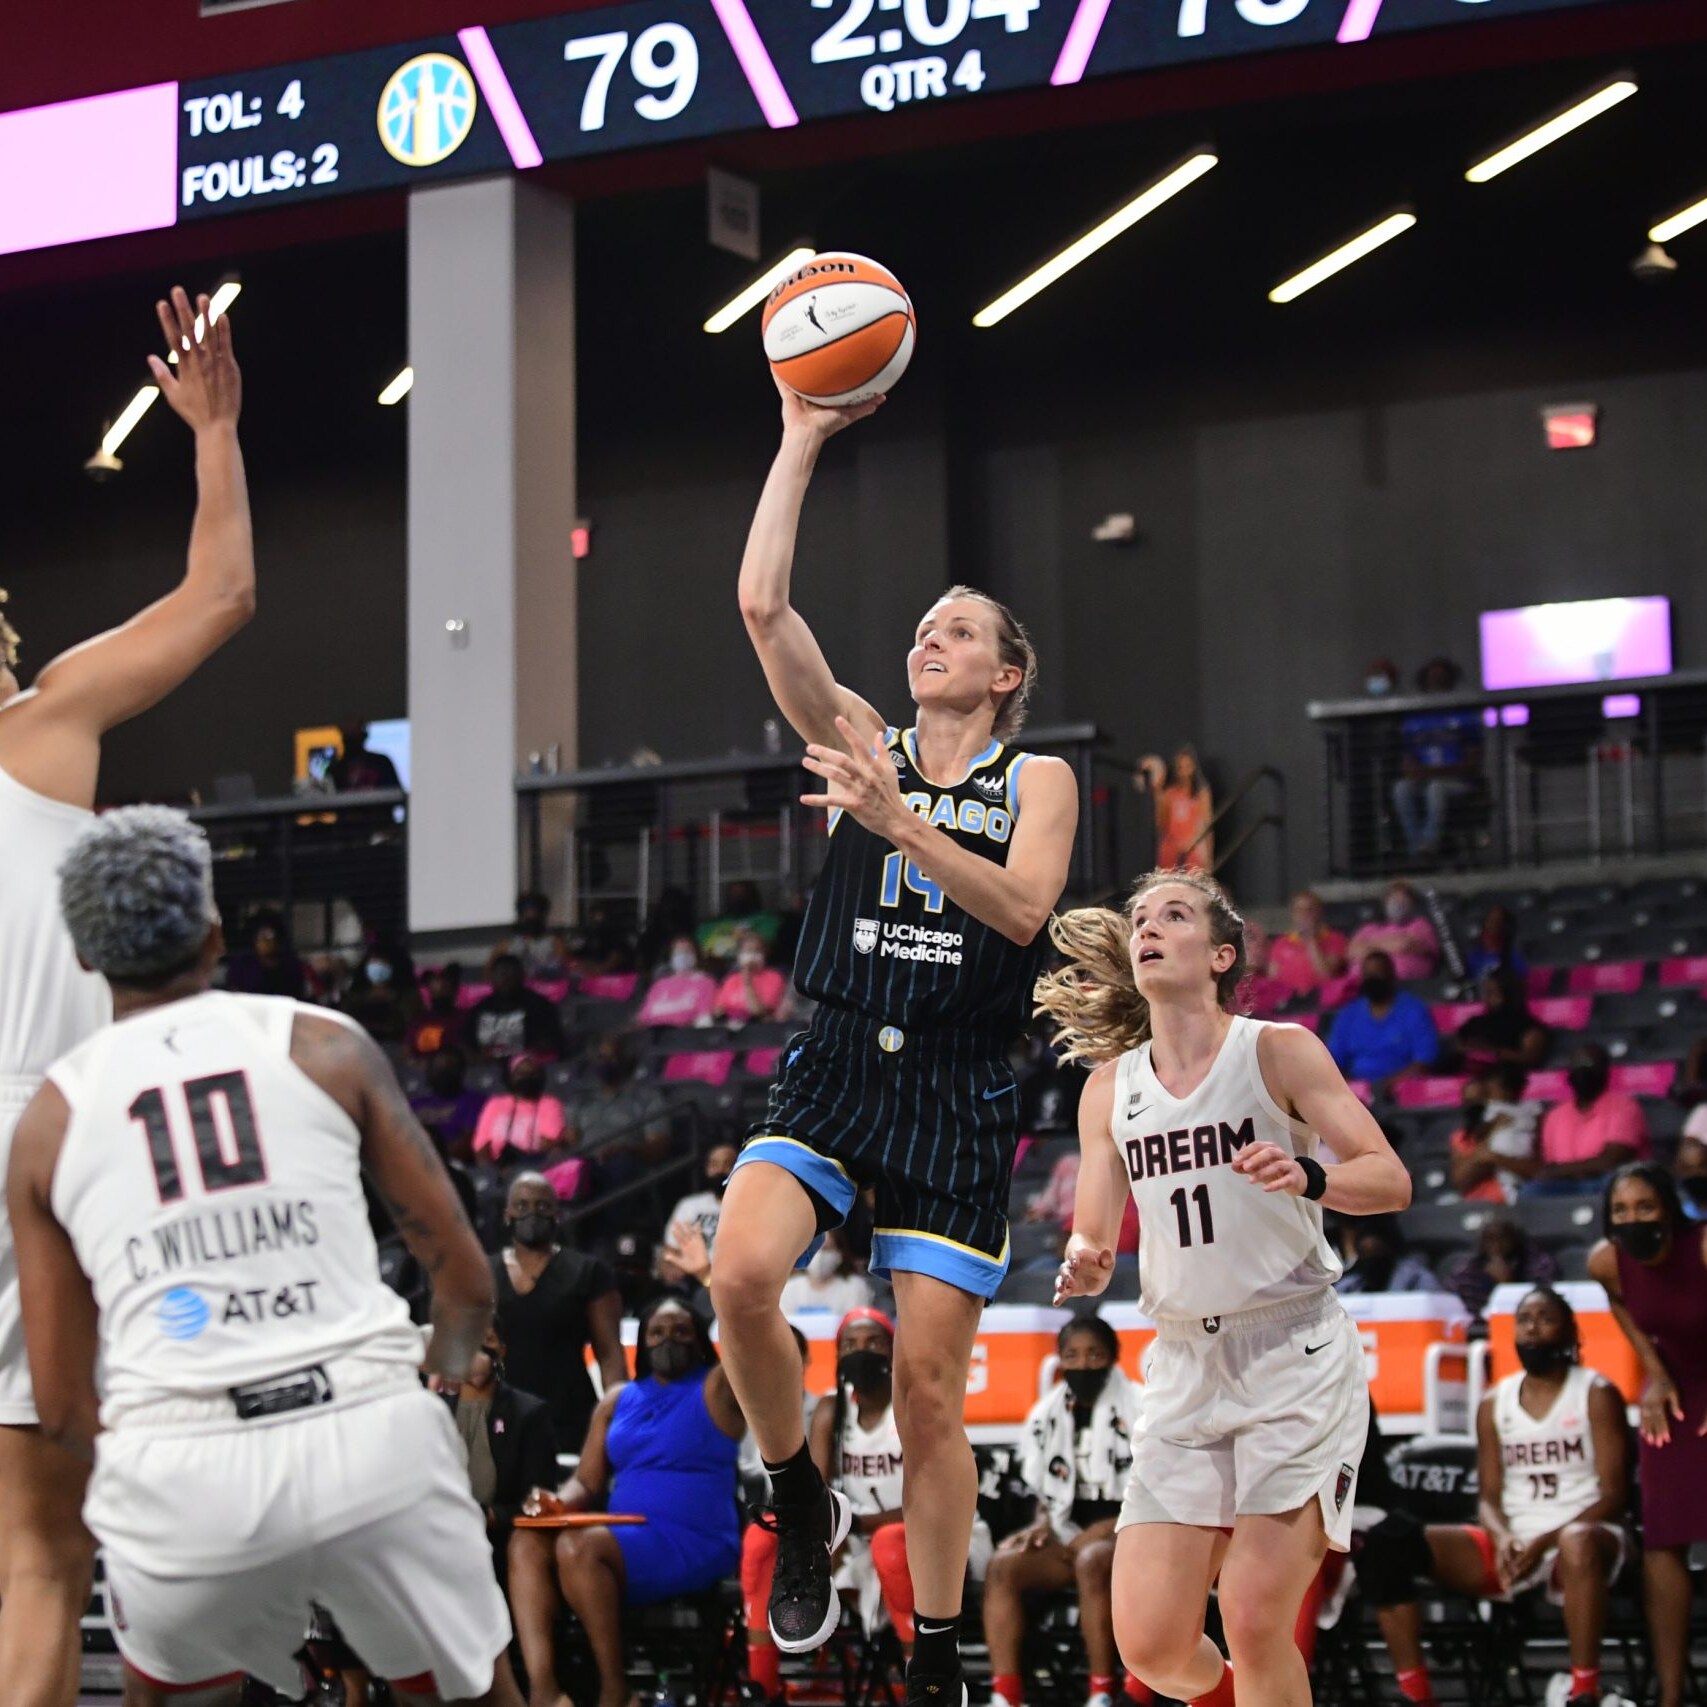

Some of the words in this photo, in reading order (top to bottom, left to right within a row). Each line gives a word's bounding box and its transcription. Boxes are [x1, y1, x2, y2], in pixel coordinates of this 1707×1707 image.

[564, 22, 699, 131] 79
[860, 56, 948, 111] QTR
[952, 49, 986, 92] 4
[183, 91, 262, 137] TOL:
[276, 79, 305, 120] 4
[182, 150, 306, 207] FOULS:
[311, 142, 339, 184] 2
[899, 791, 1012, 844] CAGO
[880, 940, 962, 965] Medicine
[883, 922, 963, 948] UChicago
[128, 1069, 270, 1206] 10
[1125, 1117, 1256, 1182] DREAM
[125, 1200, 319, 1283] C.WILLIAMS
[1170, 1183, 1215, 1249] 11
[222, 1281, 319, 1324] AT&T
[842, 1452, 903, 1477] DREAM
[1390, 1464, 1463, 1493] AT&T
[1503, 1437, 1585, 1466] DREAM
